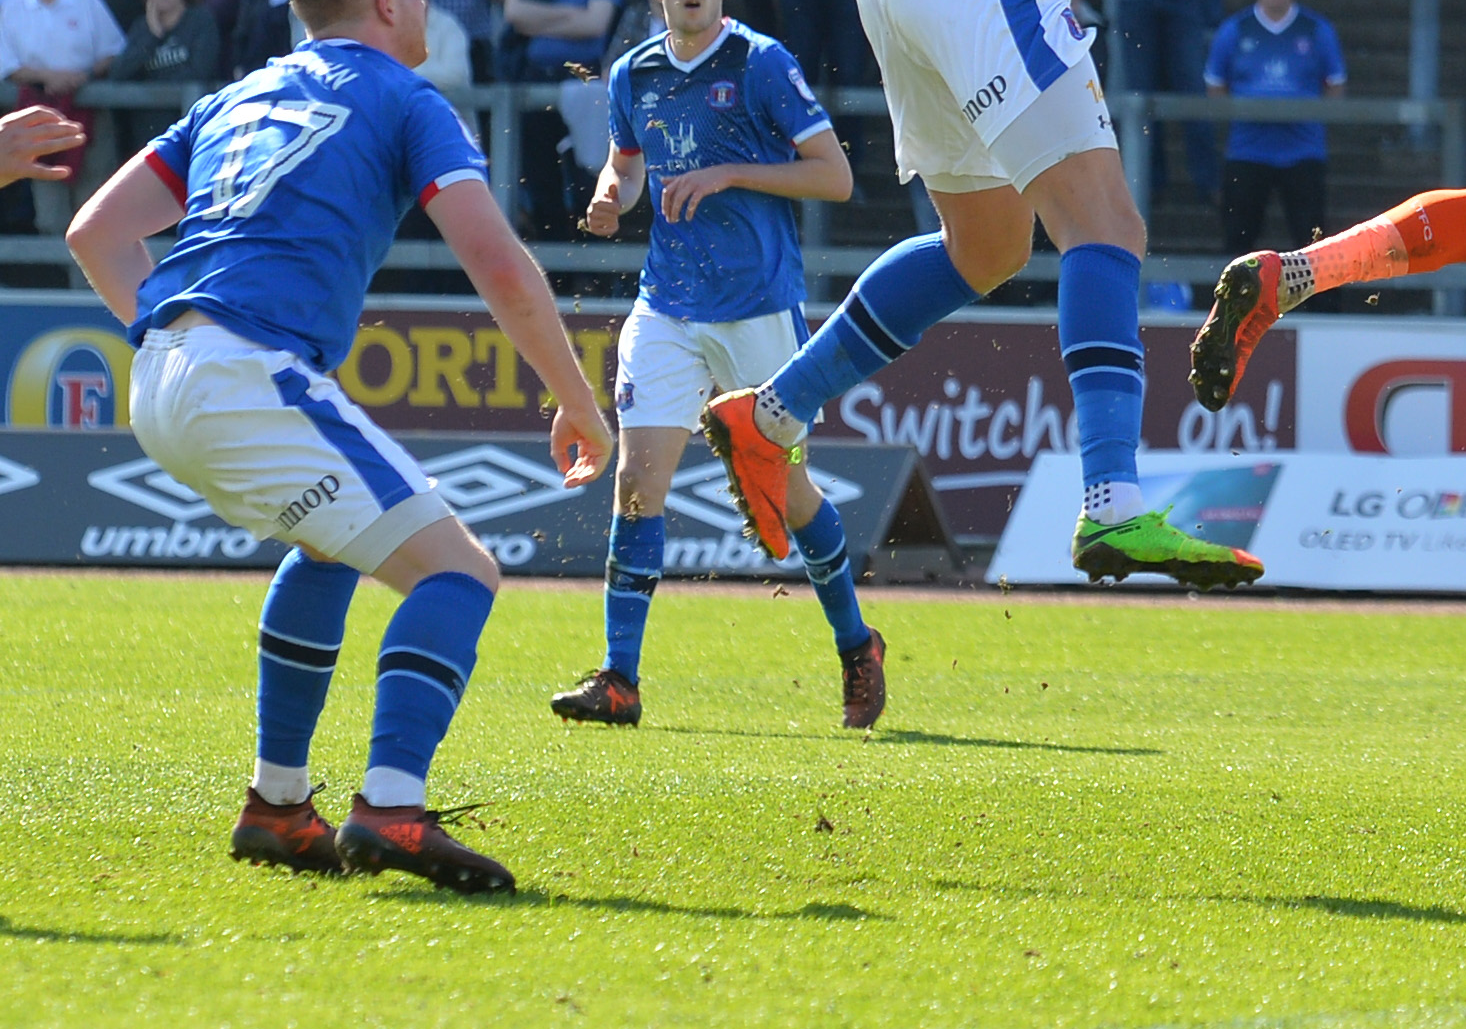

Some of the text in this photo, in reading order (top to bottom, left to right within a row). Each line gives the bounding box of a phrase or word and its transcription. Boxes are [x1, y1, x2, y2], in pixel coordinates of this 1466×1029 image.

[202, 100, 352, 221] 17
[840, 375, 1285, 461] Switch on!
[1330, 489, 1384, 518] LG
[80, 523, 262, 560] umbro
